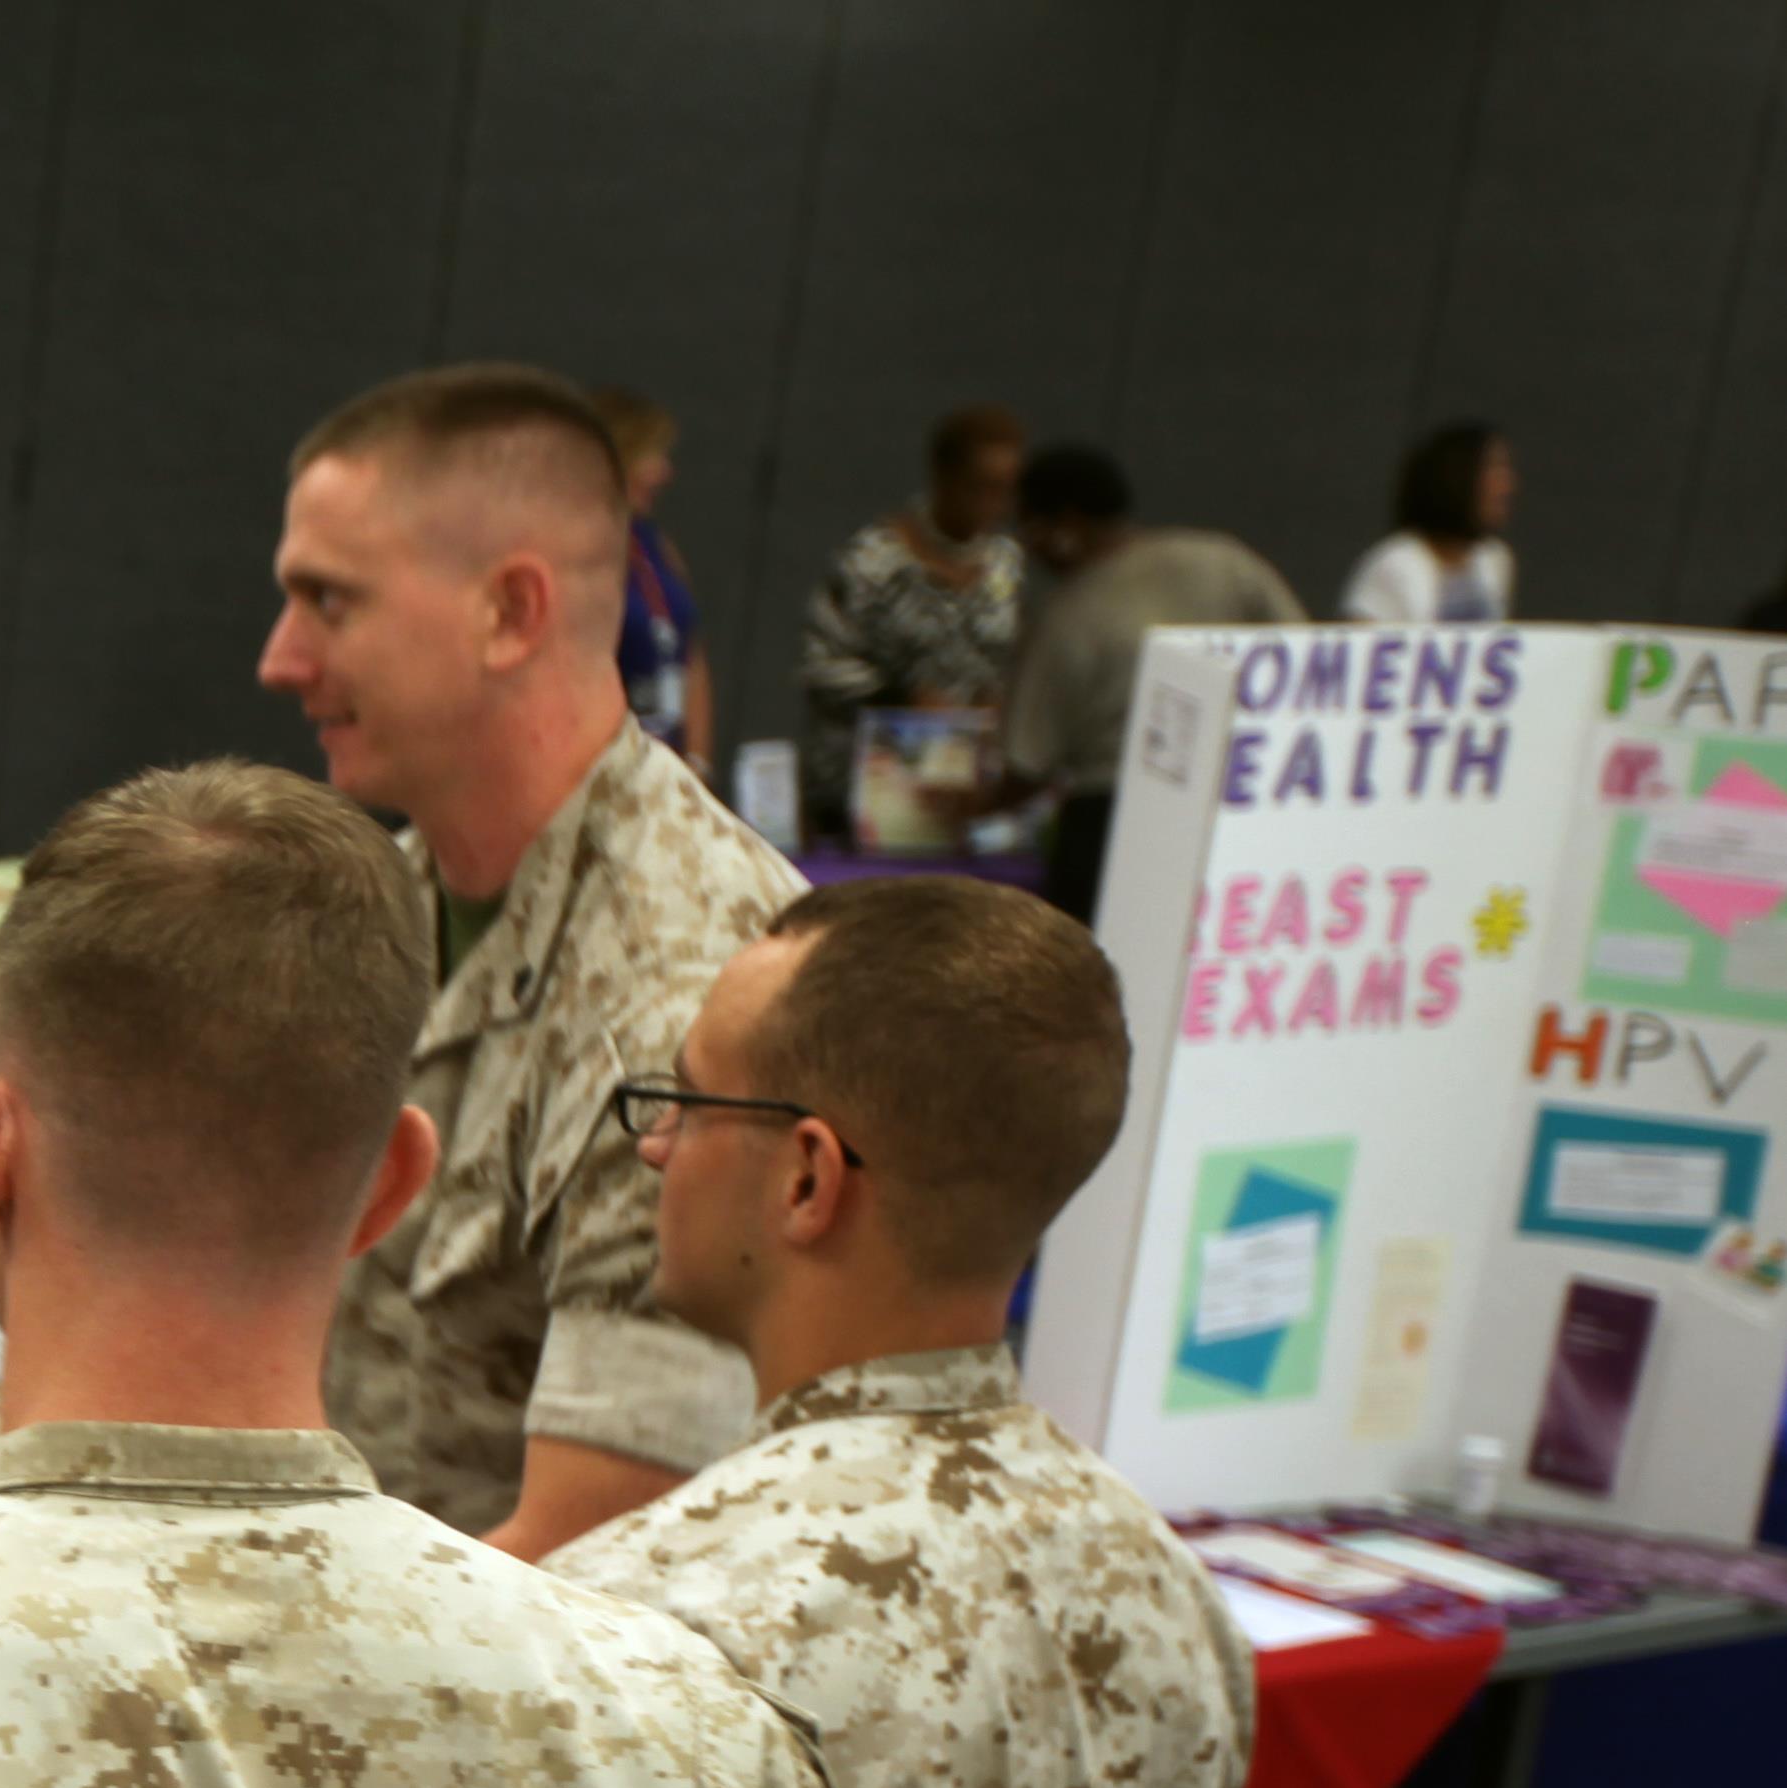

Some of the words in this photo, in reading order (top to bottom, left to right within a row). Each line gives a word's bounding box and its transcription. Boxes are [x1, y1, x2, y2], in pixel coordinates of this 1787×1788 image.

[1210, 634, 1522, 714] OMENS
[1221, 723, 1510, 807] EALTH
[1191, 866, 1429, 956] EAST
[1182, 944, 1464, 1042] EXAMS
[1527, 1003, 1767, 1106] HPV
